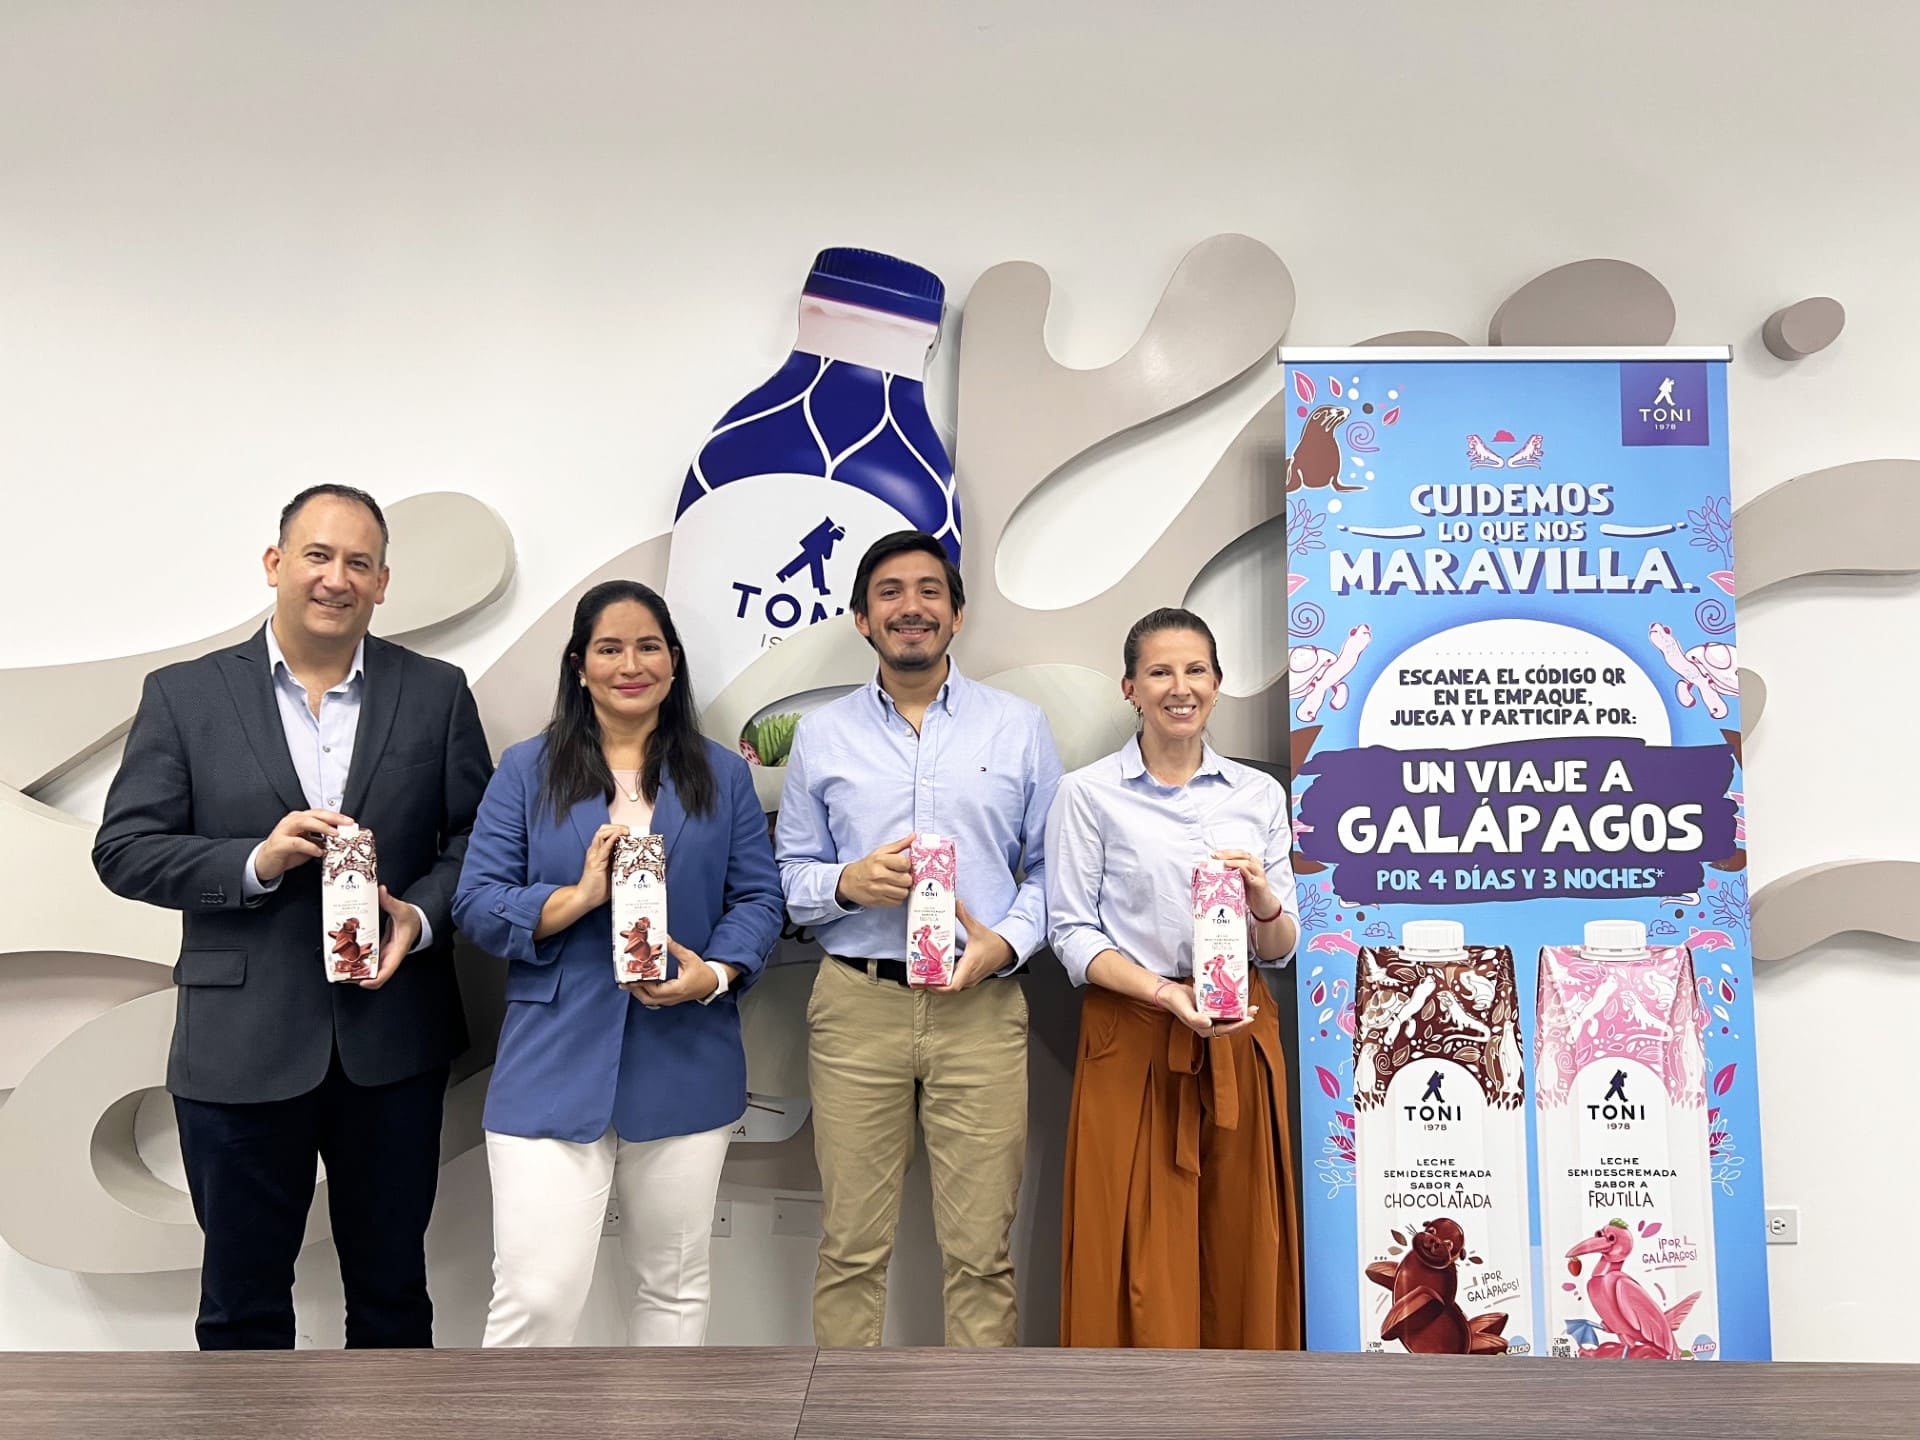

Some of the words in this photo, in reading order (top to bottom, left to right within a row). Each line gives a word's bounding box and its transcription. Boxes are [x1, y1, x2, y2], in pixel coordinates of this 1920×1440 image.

[1638, 408, 1692, 422] TONI
[1410, 483, 1613, 516] CUIDEMOS
[1438, 521, 1472, 542] LO
[1480, 521, 1527, 543] QUE
[1535, 521, 1586, 541] NOS
[1329, 547, 1700, 594] MARAVILLA.
[1399, 669, 1491, 686] ESCANEA
[1497, 669, 1519, 685] EL
[1525, 664, 1596, 685] CÓDIGO
[1602, 668, 1626, 686] QR
[1434, 690, 1460, 706] EN
[1465, 689, 1488, 705] EL
[1494, 689, 1593, 707] EMPAQUE,
[1390, 710, 1456, 726] JUEGA
[1461, 710, 1474, 725] Y
[1480, 709, 1590, 725] PARTICIPA
[1595, 708, 1637, 725] POR:
[1402, 761, 1455, 793] UN
[1466, 761, 1588, 793] VIAJE
[1599, 761, 1633, 792] A
[1337, 797, 1703, 854] GALÁPAGOS
[1376, 869, 1420, 890] POR
[1428, 869, 1448, 890] 4
[1455, 864, 1515, 890] DÍAS
[1520, 868, 1537, 889] Y
[1543, 868, 1557, 889] 3
[1403, 1105, 1462, 1122] TONI
[1586, 1104, 1645, 1121] TONI
[1416, 1158, 1455, 1167] LECHE
[1600, 1157, 1639, 1166] LECHE
[1383, 1170, 1492, 1179] SEMIDESCREMADA
[1567, 1168, 1677, 1178] SEMIDESCREMADA
[1410, 1181, 1451, 1190] SABOR
[1455, 1181, 1464, 1189] A
[1594, 1180, 1635, 1189] SABOR
[1639, 1180, 1648, 1188] A
[1384, 1191, 1492, 1209] CHOCOLATADA
[1588, 1190, 1654, 1209] FRUTILLA
